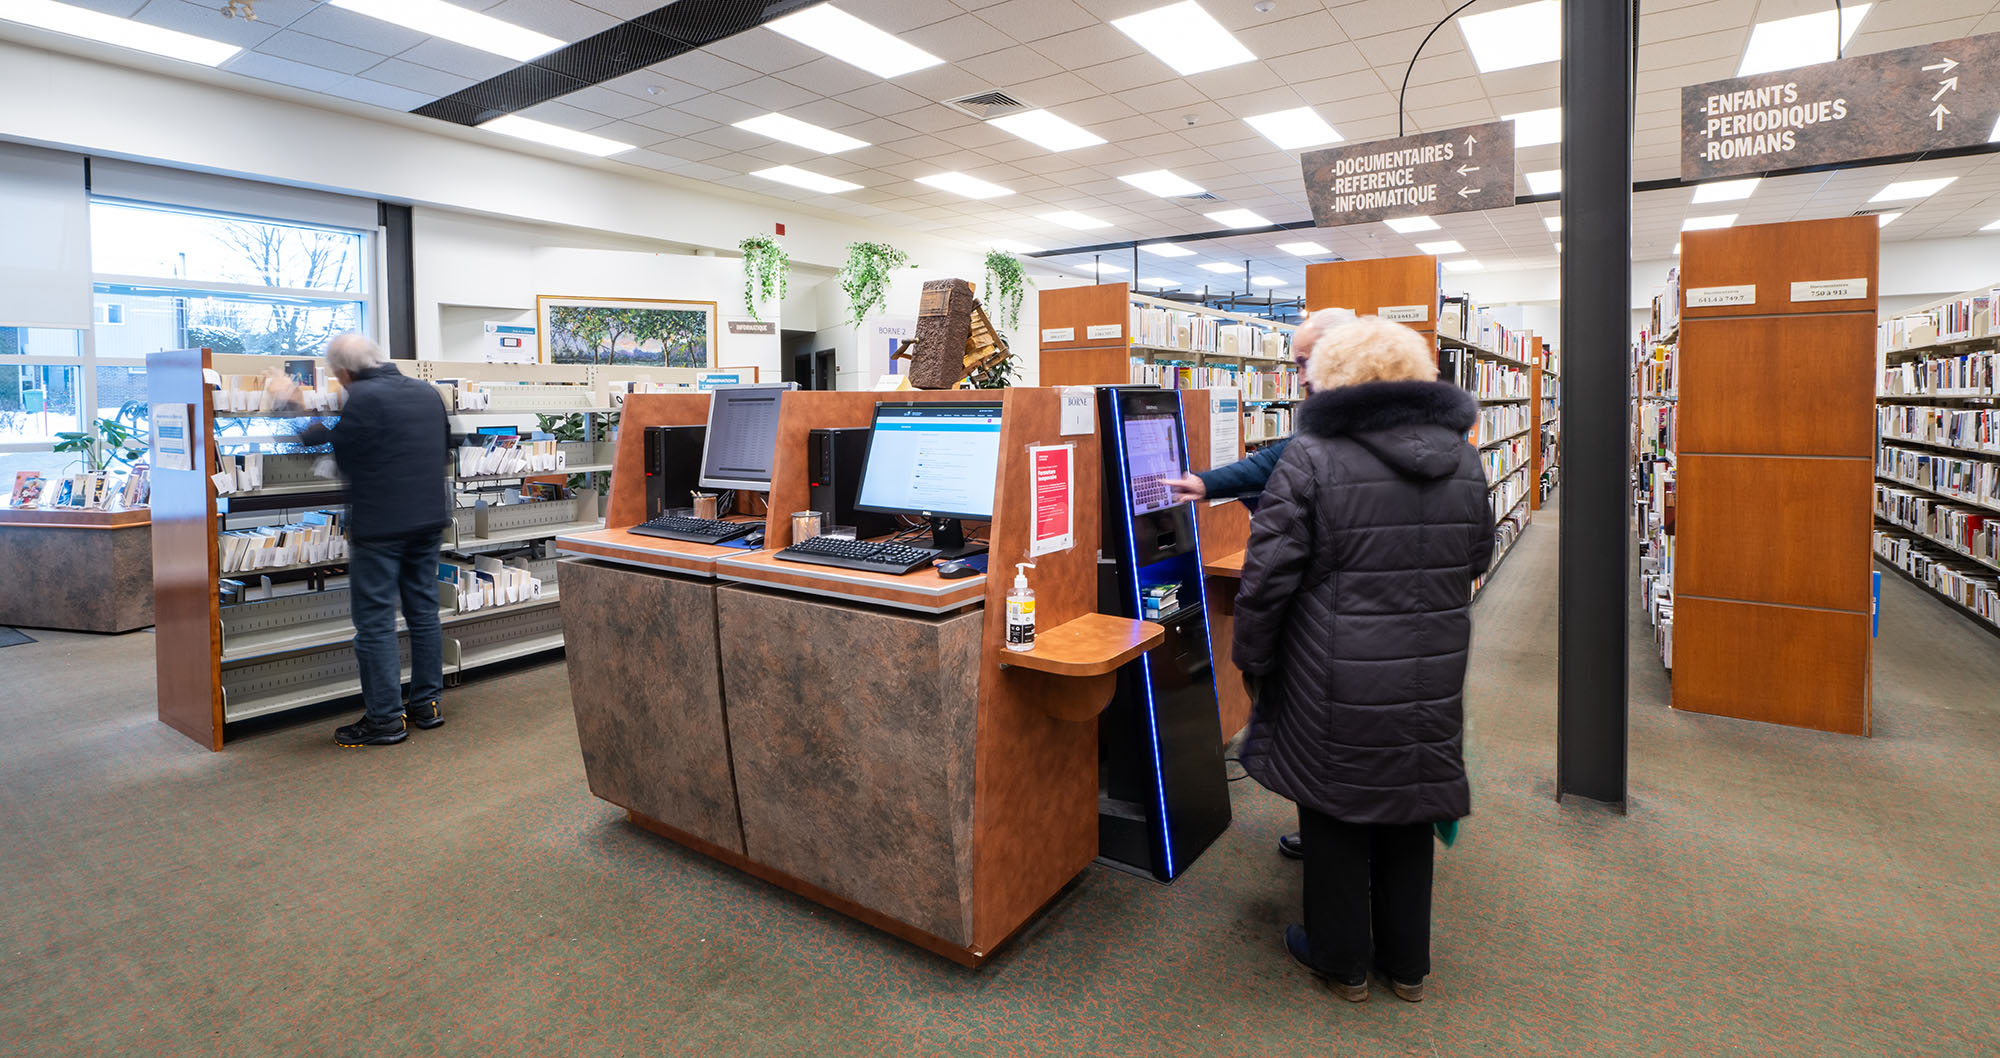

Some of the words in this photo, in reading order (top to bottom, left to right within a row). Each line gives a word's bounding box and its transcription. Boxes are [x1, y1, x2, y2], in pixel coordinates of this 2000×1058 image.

[1700, 82, 1798, 116] -ENFANTS
[1700, 98, 1848, 139] -PERIODIQUES
[1331, 142, 1454, 177] -DOCUMENTAIRES
[1700, 130, 1796, 162] -ROMANS
[1331, 167, 1414, 194] -REFERENCE
[1331, 184, 1437, 213] -INFORMATIQUE
[878, 326, 900, 336] BORNE
[901, 328, 906, 336] 2
[1068, 398, 1088, 407] BORNE
[558, 455, 564, 466] P
[533, 583, 539, 595] R
